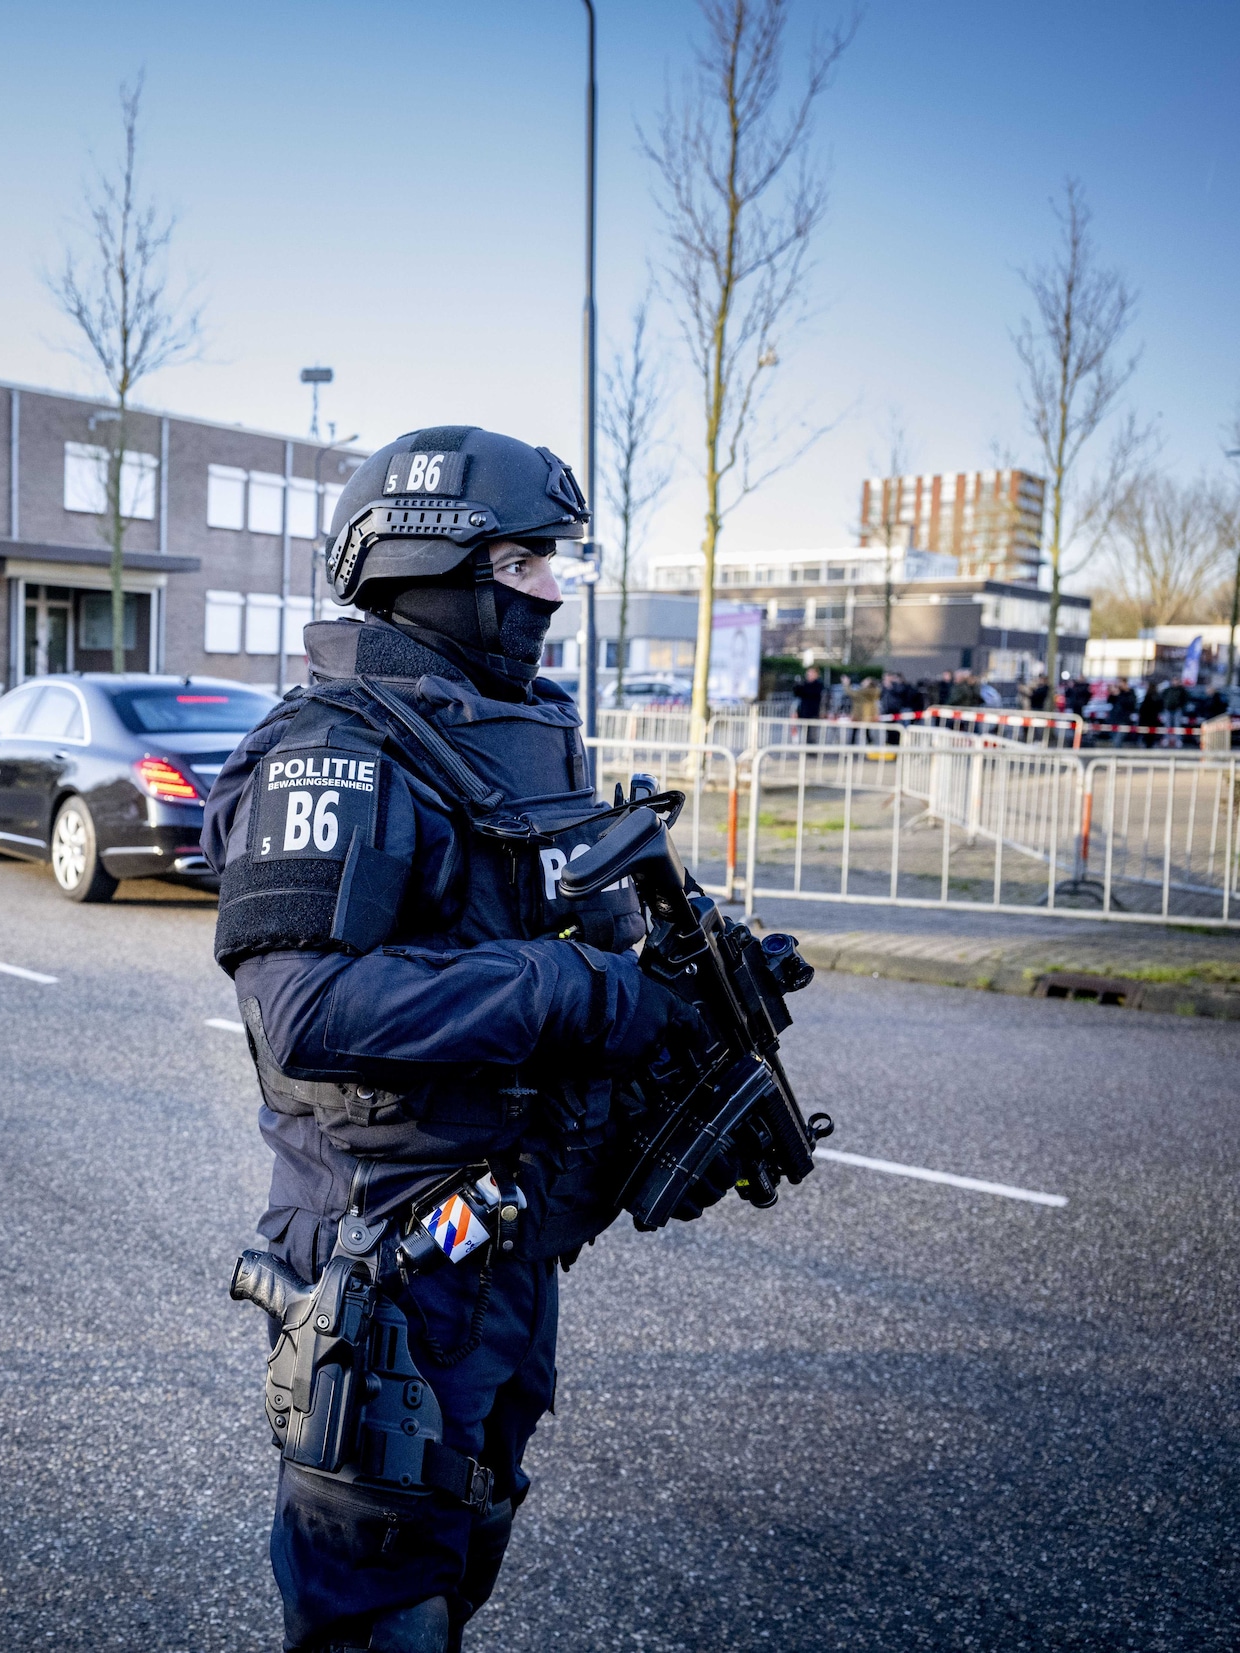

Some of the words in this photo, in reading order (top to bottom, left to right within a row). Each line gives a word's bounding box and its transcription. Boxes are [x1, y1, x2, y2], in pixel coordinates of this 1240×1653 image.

[386, 474, 398, 493] 5
[406, 454, 445, 492] B6
[267, 777, 374, 792] BEWAKINGSEENHEID
[268, 757, 376, 783] POLITIE
[260, 836, 272, 856] 5
[283, 790, 340, 852] B6
